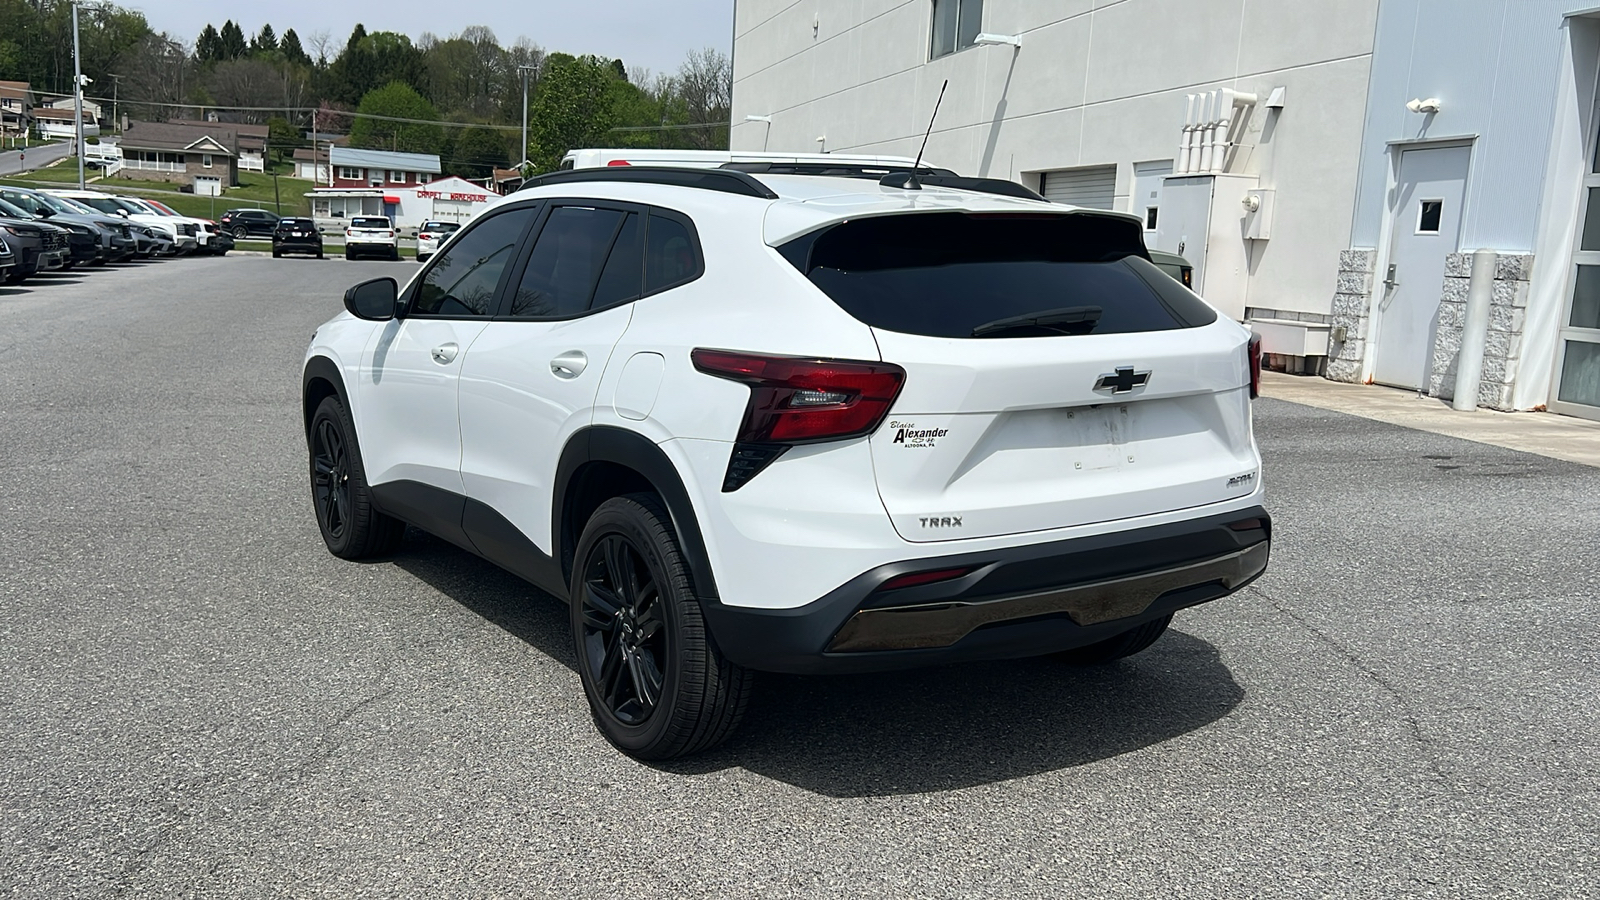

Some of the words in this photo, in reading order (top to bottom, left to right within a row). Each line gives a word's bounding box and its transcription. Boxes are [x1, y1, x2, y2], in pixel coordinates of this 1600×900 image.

[417, 190, 442, 199] CARPET
[450, 193, 487, 203] WAREHOUSE
[893, 428, 949, 443] Alexander
[918, 516, 963, 528] TRAX
